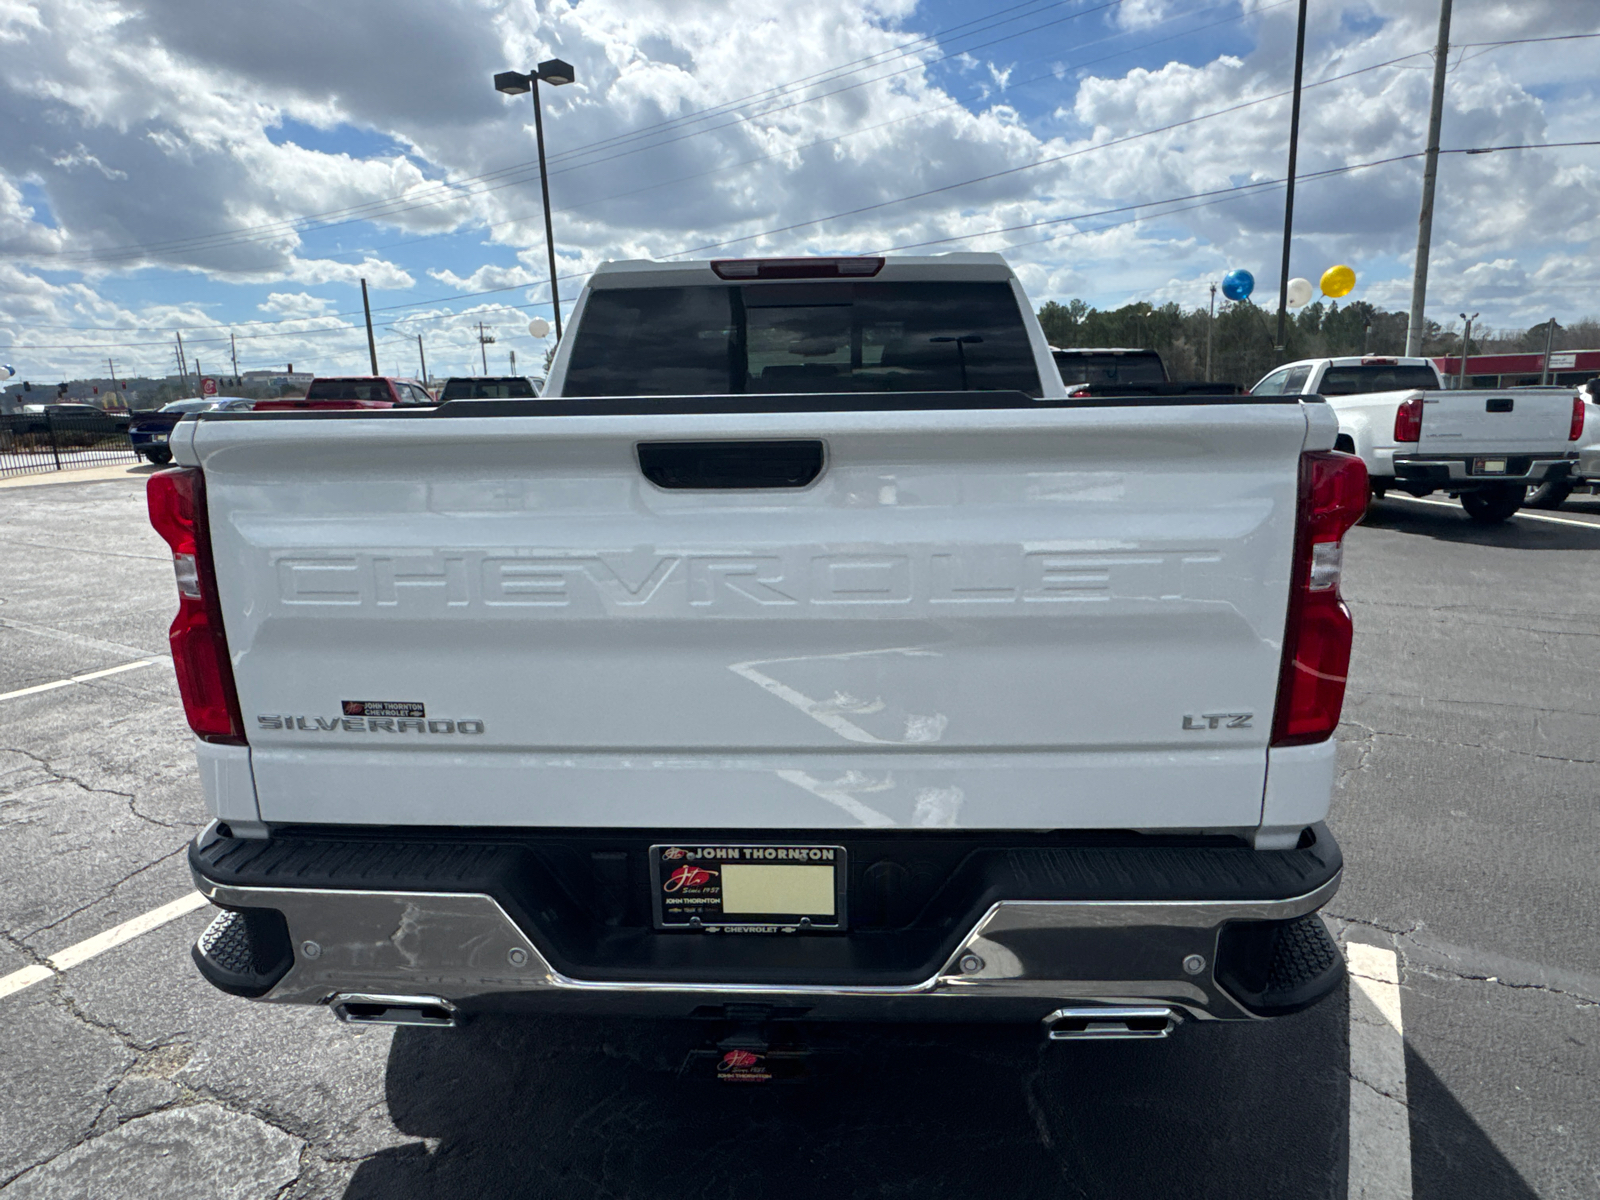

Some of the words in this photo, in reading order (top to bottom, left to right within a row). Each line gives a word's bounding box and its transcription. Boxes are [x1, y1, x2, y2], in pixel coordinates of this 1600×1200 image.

[274, 549, 1223, 606] CHEVROLET
[364, 702, 383, 710] JOHN
[384, 703, 422, 711] THORNTON
[364, 709, 410, 717] CHEVROLET
[256, 713, 485, 735] SILVERADO
[1181, 711, 1254, 730] LTZ
[695, 847, 740, 859] JOHN
[744, 848, 835, 861] THORNTON
[702, 886, 720, 894] 1957
[723, 926, 779, 934] CHEVROLET
